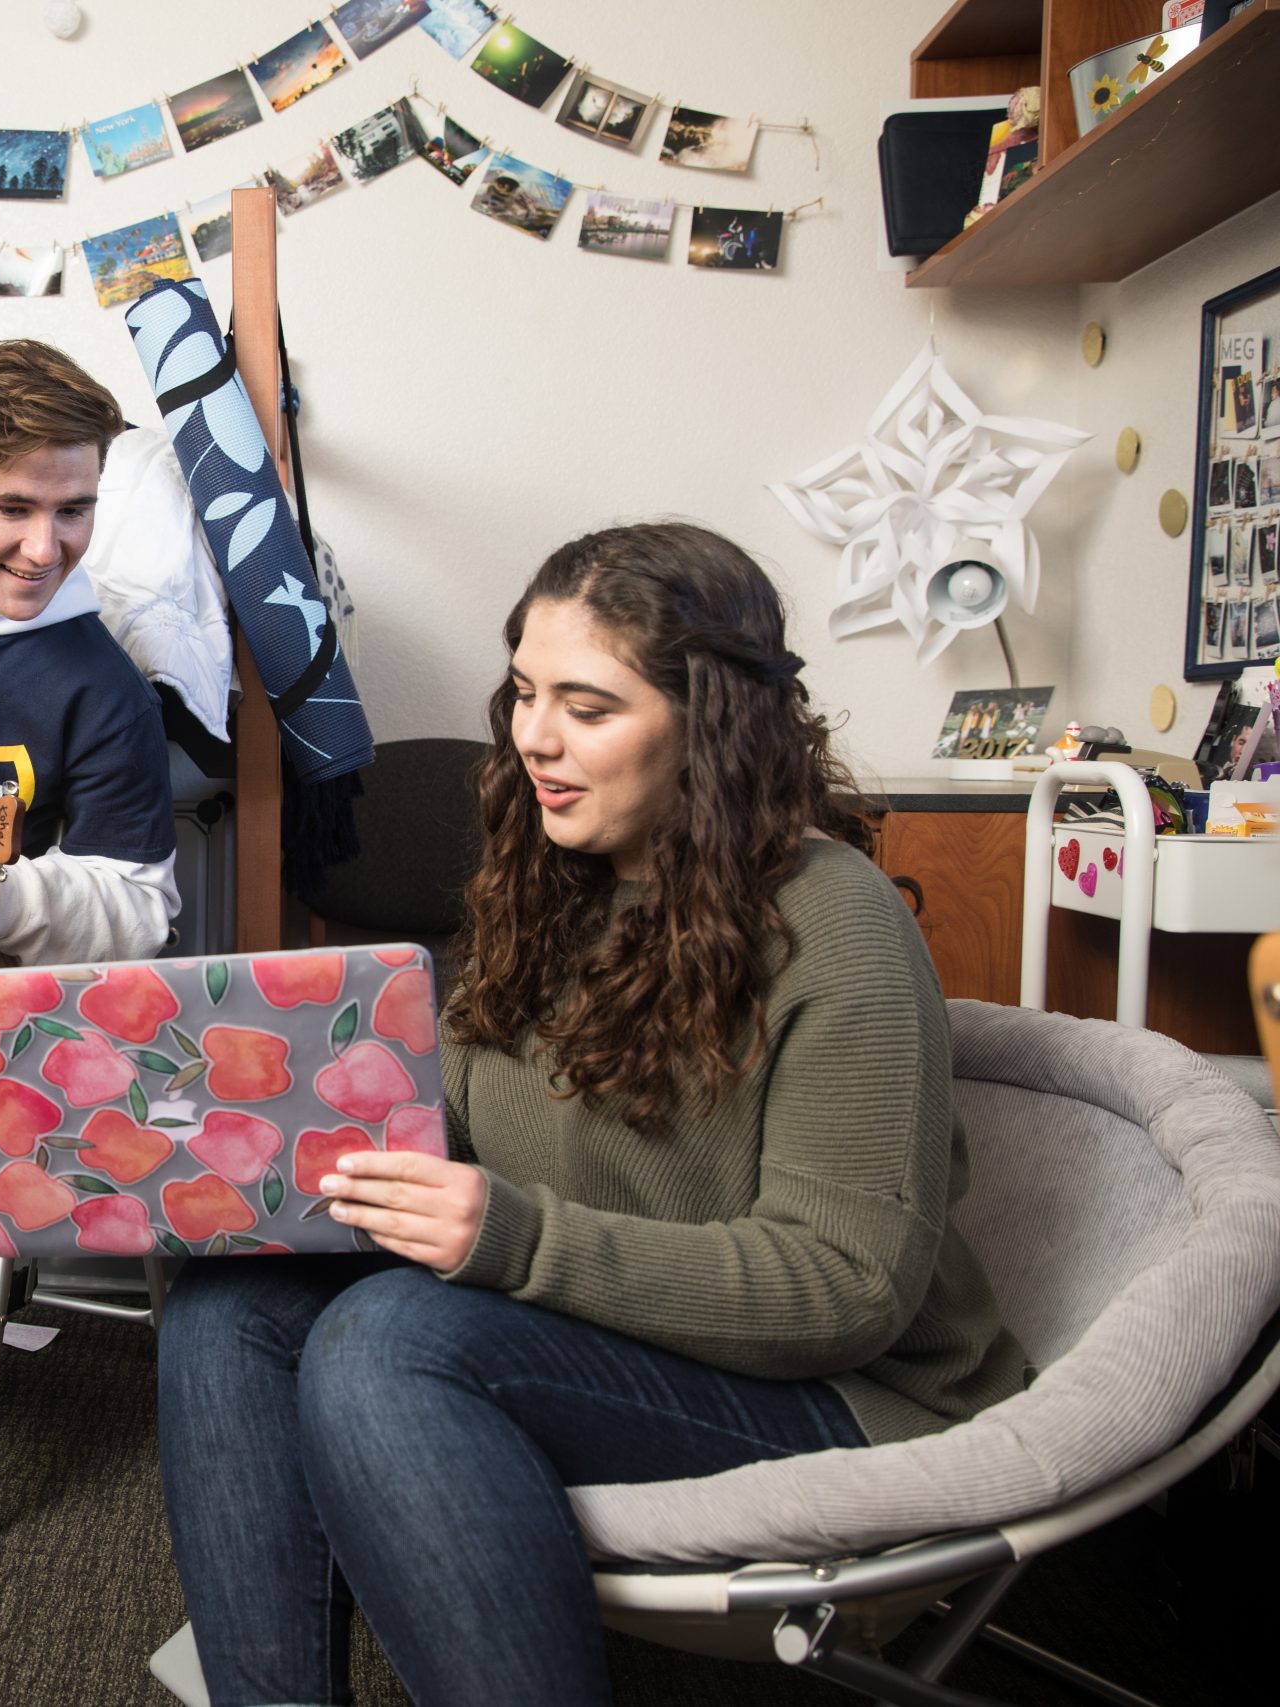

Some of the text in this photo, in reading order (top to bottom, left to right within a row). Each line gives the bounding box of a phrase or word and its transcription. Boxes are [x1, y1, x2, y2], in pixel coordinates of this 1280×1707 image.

[95, 114, 137, 135] New York
[1221, 337, 1255, 360] MEG
[957, 736, 1030, 760] 2017
